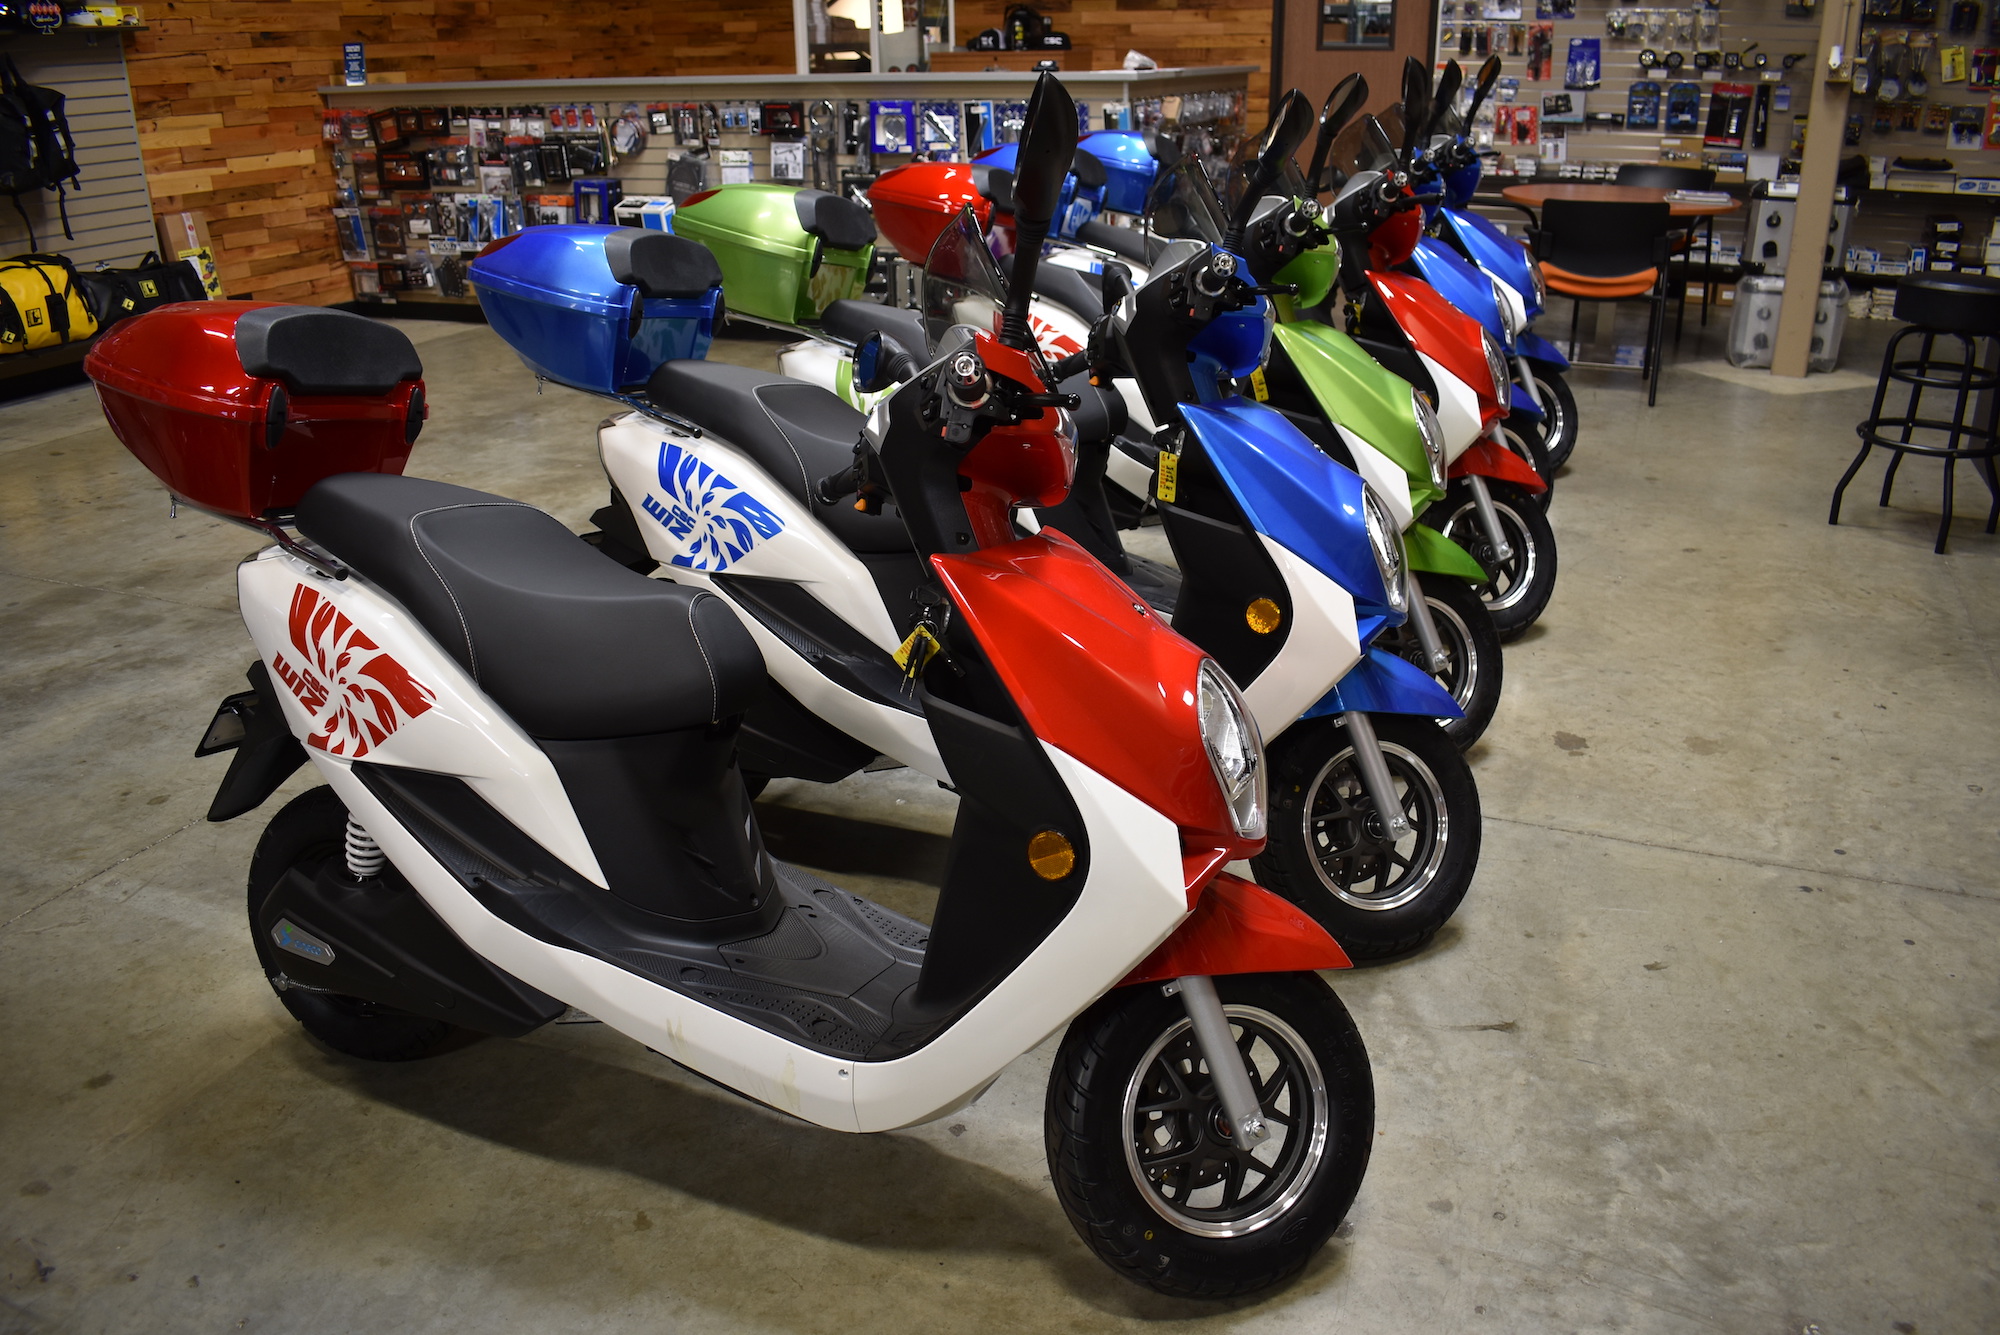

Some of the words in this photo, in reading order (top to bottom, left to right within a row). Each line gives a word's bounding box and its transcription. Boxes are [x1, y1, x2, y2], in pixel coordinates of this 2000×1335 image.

[641, 493, 694, 541] WIZ
[671, 504, 696, 528] CSC
[272, 651, 326, 717] WIZ
[303, 668, 329, 702] CSC
